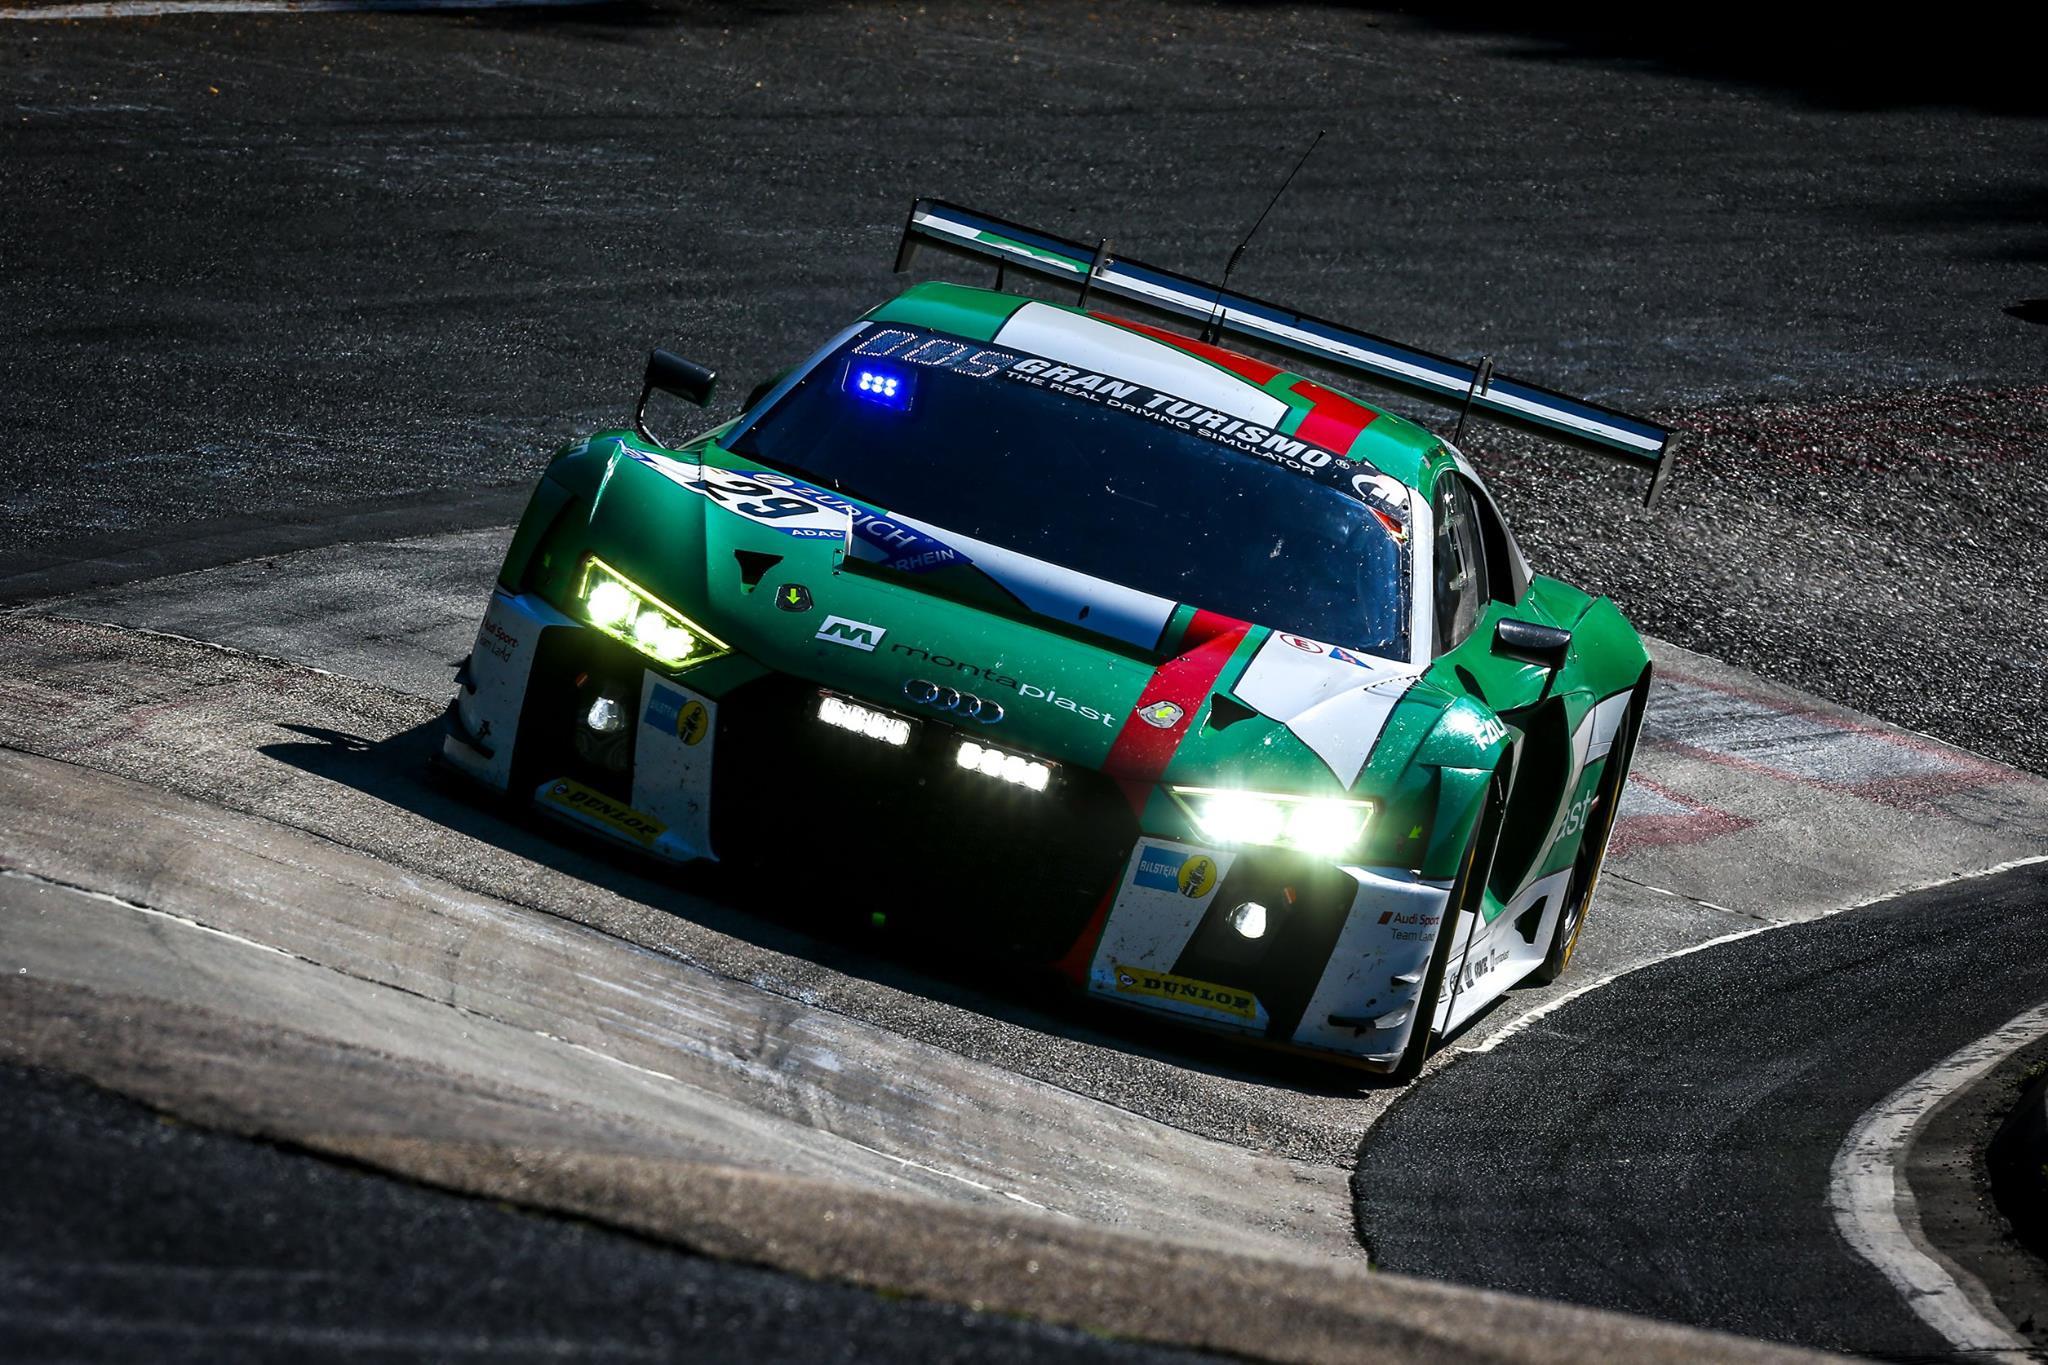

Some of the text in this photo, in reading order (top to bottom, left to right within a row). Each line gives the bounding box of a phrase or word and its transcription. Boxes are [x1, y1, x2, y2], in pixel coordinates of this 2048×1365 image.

[1012, 358, 1141, 400] GRAN
[1006, 370, 1316, 477] THE REAL DRIVING SIMULATOR
[684, 478, 819, 519] 29
[790, 486, 917, 548] ZURICH
[791, 528, 844, 539] ADAC
[887, 548, 956, 571] RHEIN
[890, 642, 1118, 728] montaplast
[569, 791, 659, 834] DUNLOP
[1138, 859, 1180, 879] BILSTEIN
[1391, 928, 1417, 941] Team
[1393, 912, 1440, 928] Audi Sport
[1143, 977, 1251, 1009] DUNLOP
